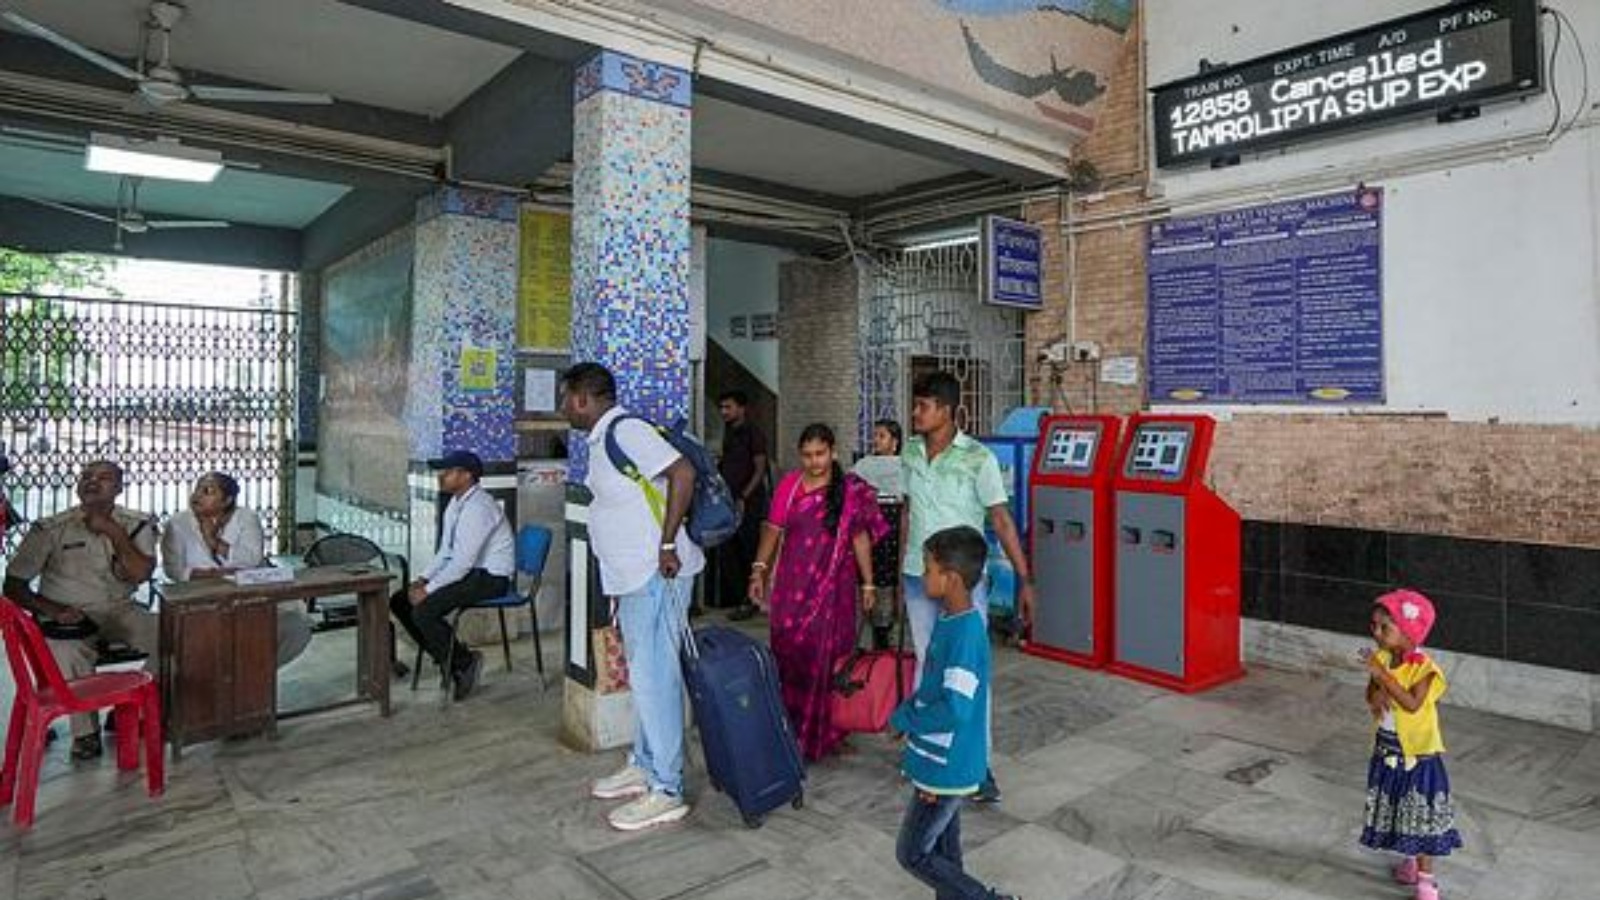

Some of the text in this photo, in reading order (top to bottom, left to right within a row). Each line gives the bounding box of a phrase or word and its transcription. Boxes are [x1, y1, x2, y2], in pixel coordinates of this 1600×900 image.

[1170, 38, 1442, 129] 12858 Cancelled
[1184, 78, 1219, 98] TRAIN
[1318, 42, 1355, 63] TIME
[1378, 29, 1406, 48] A/D
[1439, 16, 1462, 33] PF
[1467, 9, 1497, 25] No.
[1171, 61, 1486, 153] TAMROLIPTA SUP EXP
